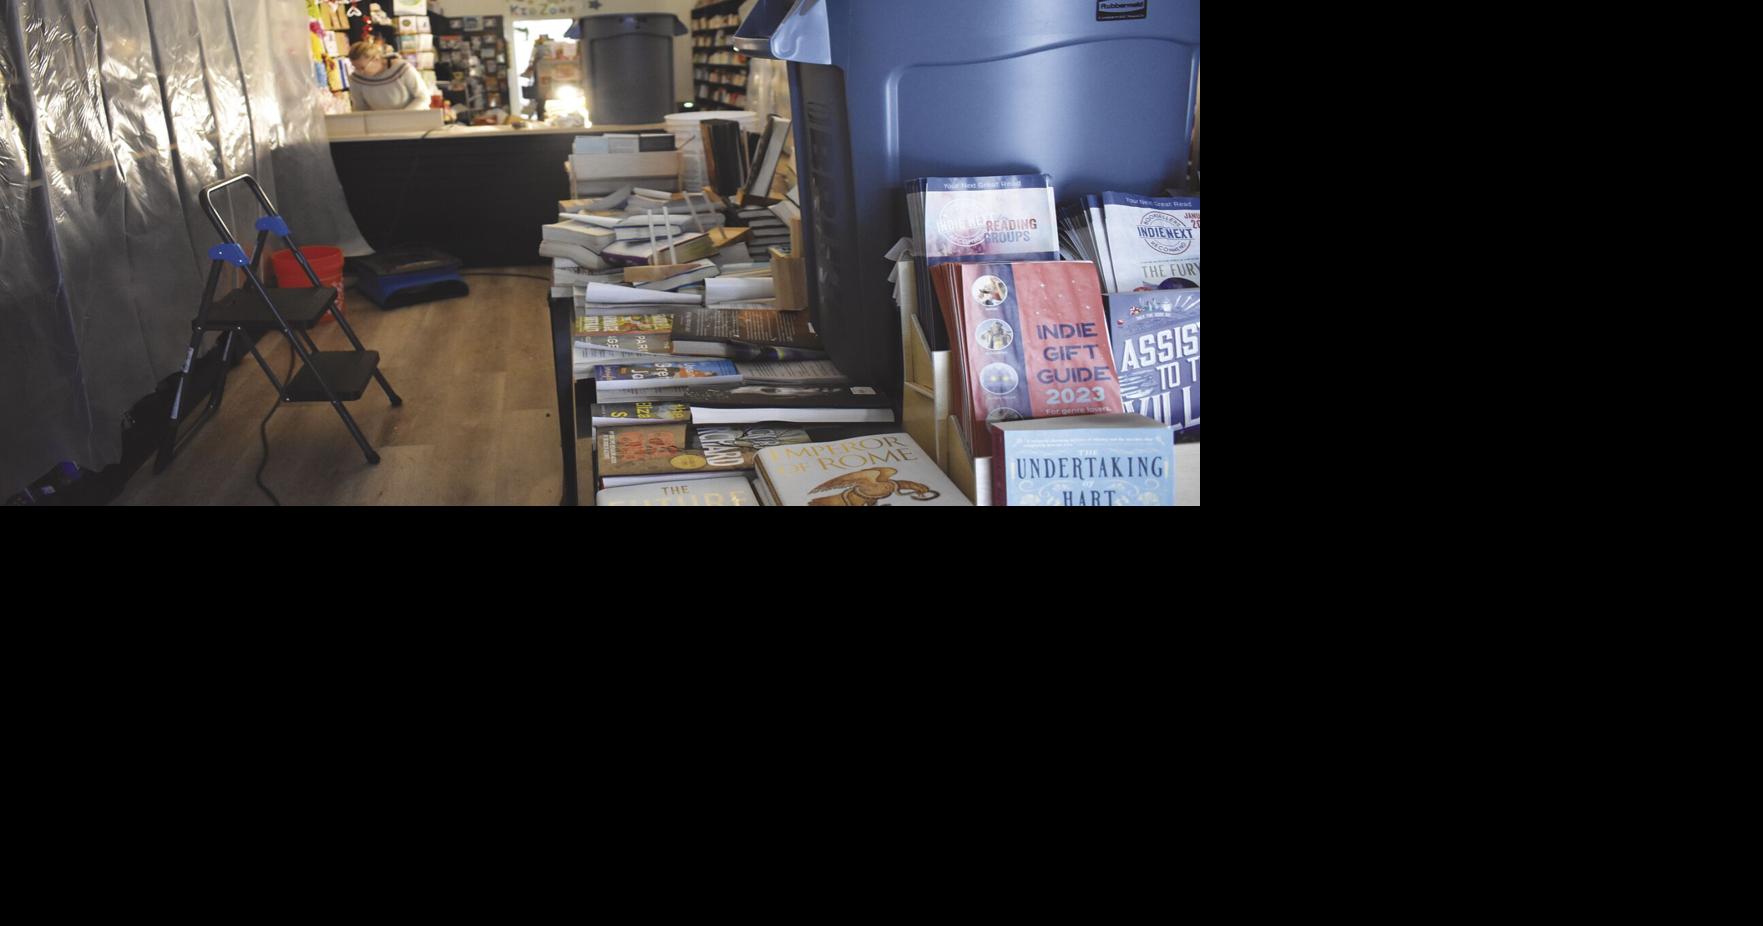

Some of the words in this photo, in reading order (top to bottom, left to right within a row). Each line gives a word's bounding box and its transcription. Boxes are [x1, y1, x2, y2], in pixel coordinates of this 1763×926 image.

[986, 218, 1038, 232] READING
[984, 231, 1031, 243] GROUPS
[1142, 263, 1167, 278] THE
[1036, 322, 1099, 341] INDIE
[1043, 344, 1099, 362] GIFT
[1121, 322, 1200, 372] ASSIS
[1036, 366, 1111, 385] GUIDE
[1156, 361, 1181, 390] TO
[1045, 386, 1105, 405] 2023
[817, 448, 918, 470] ROME
[1016, 456, 1163, 481] UNDERTAKING
[661, 485, 689, 496] THE
[1062, 490, 1117, 506] HART
